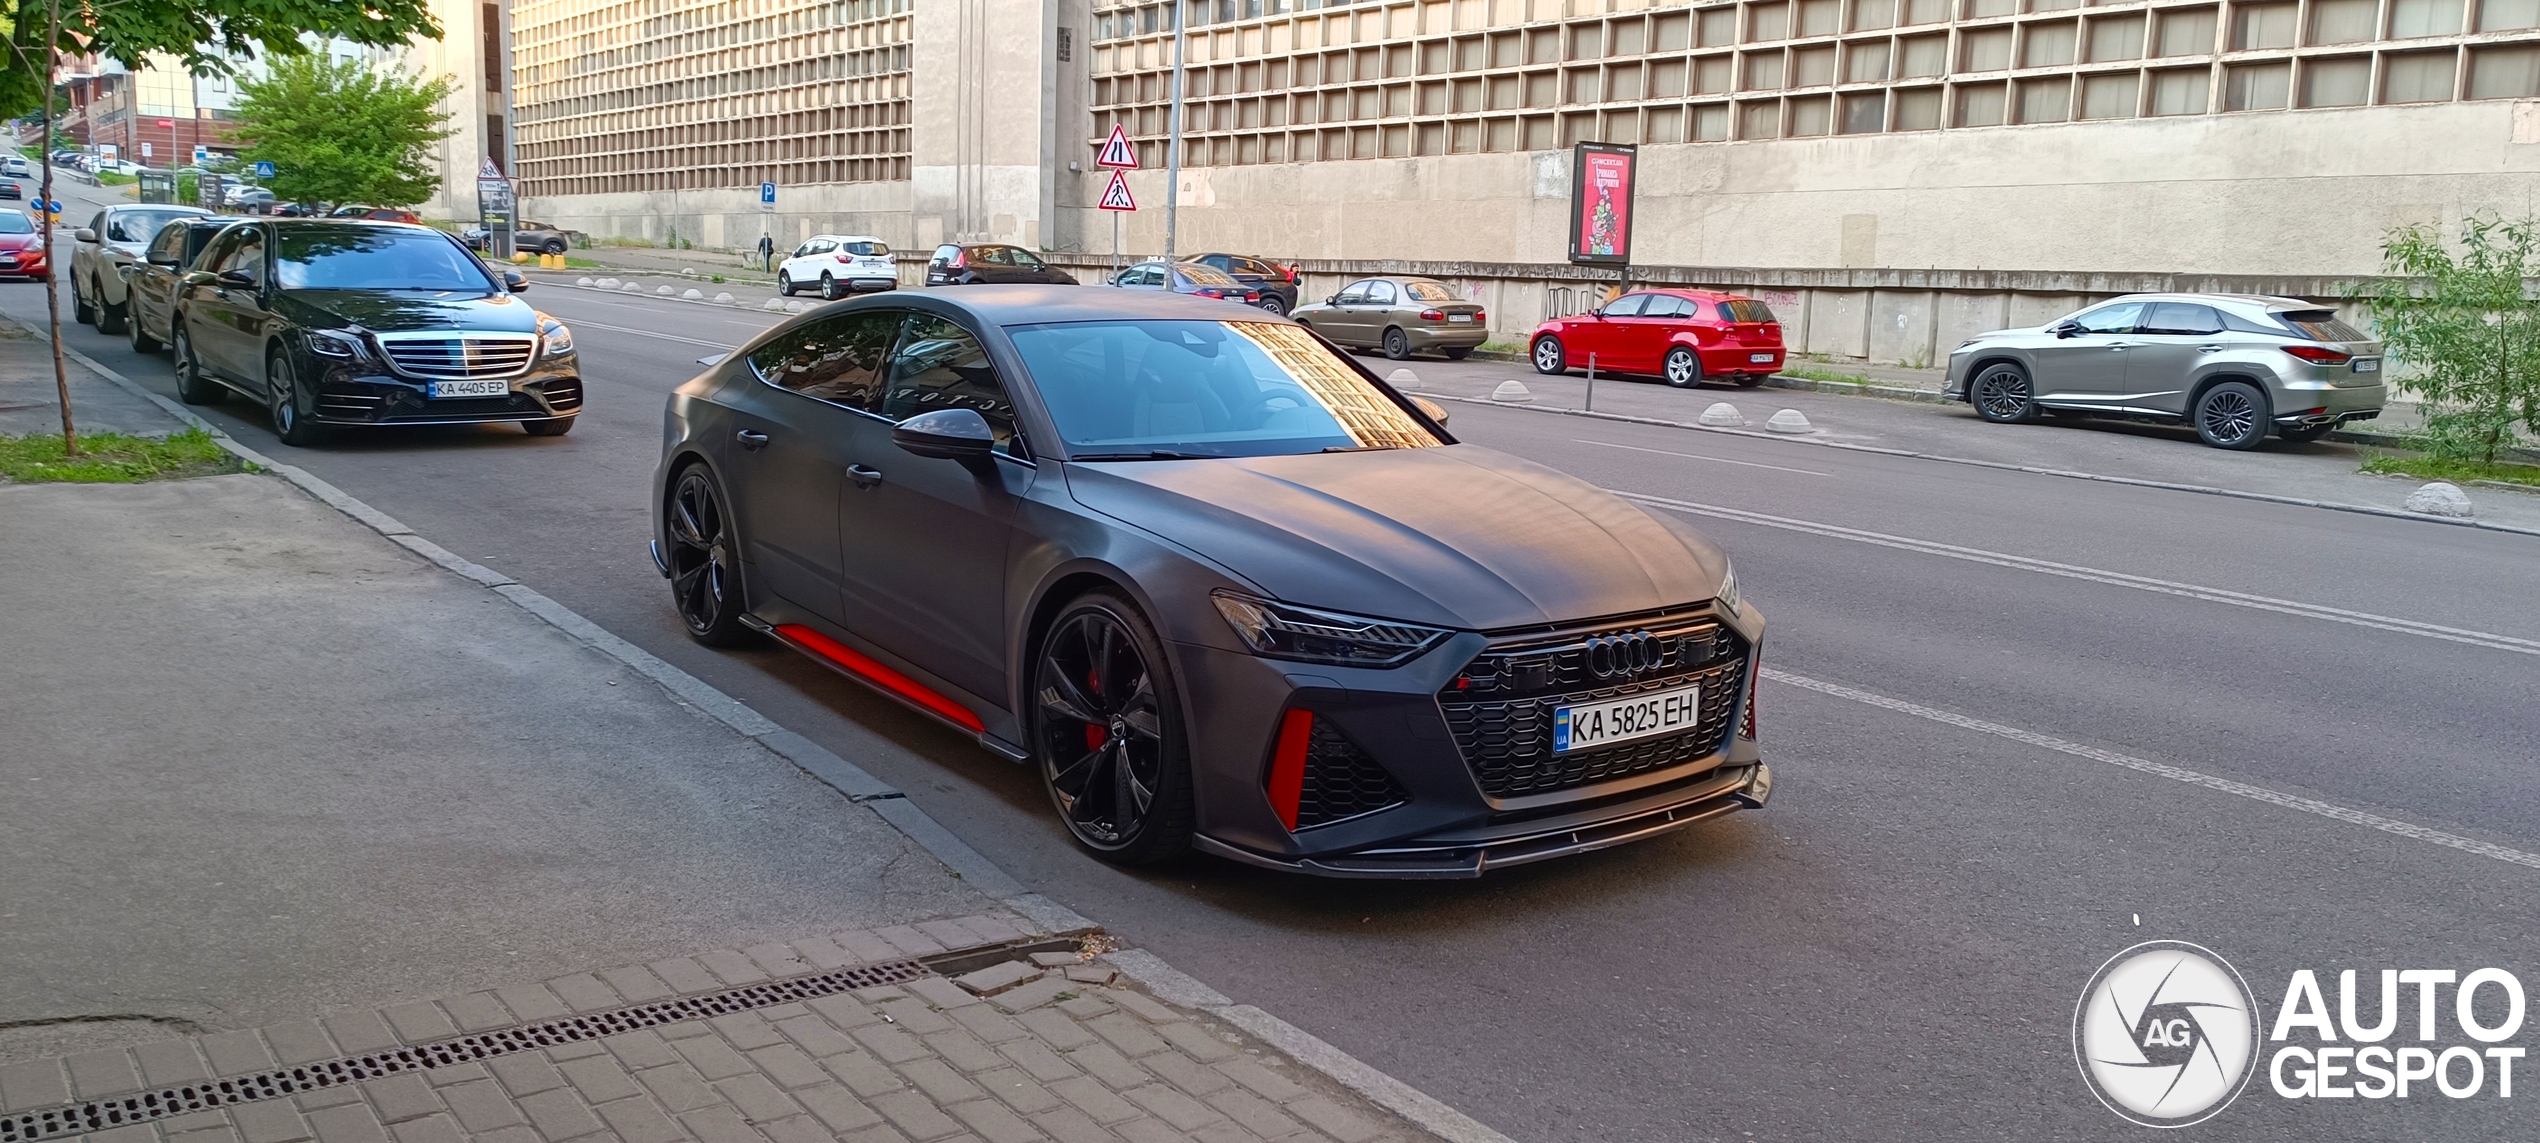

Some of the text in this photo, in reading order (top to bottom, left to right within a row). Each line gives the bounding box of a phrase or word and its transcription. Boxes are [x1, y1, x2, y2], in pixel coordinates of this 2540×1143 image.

[765, 185, 773, 201] P
[436, 382, 504, 395] KA 4405 EP
[1572, 693, 1693, 743] KA 5825 EH
[1557, 736, 1567, 745] UA
